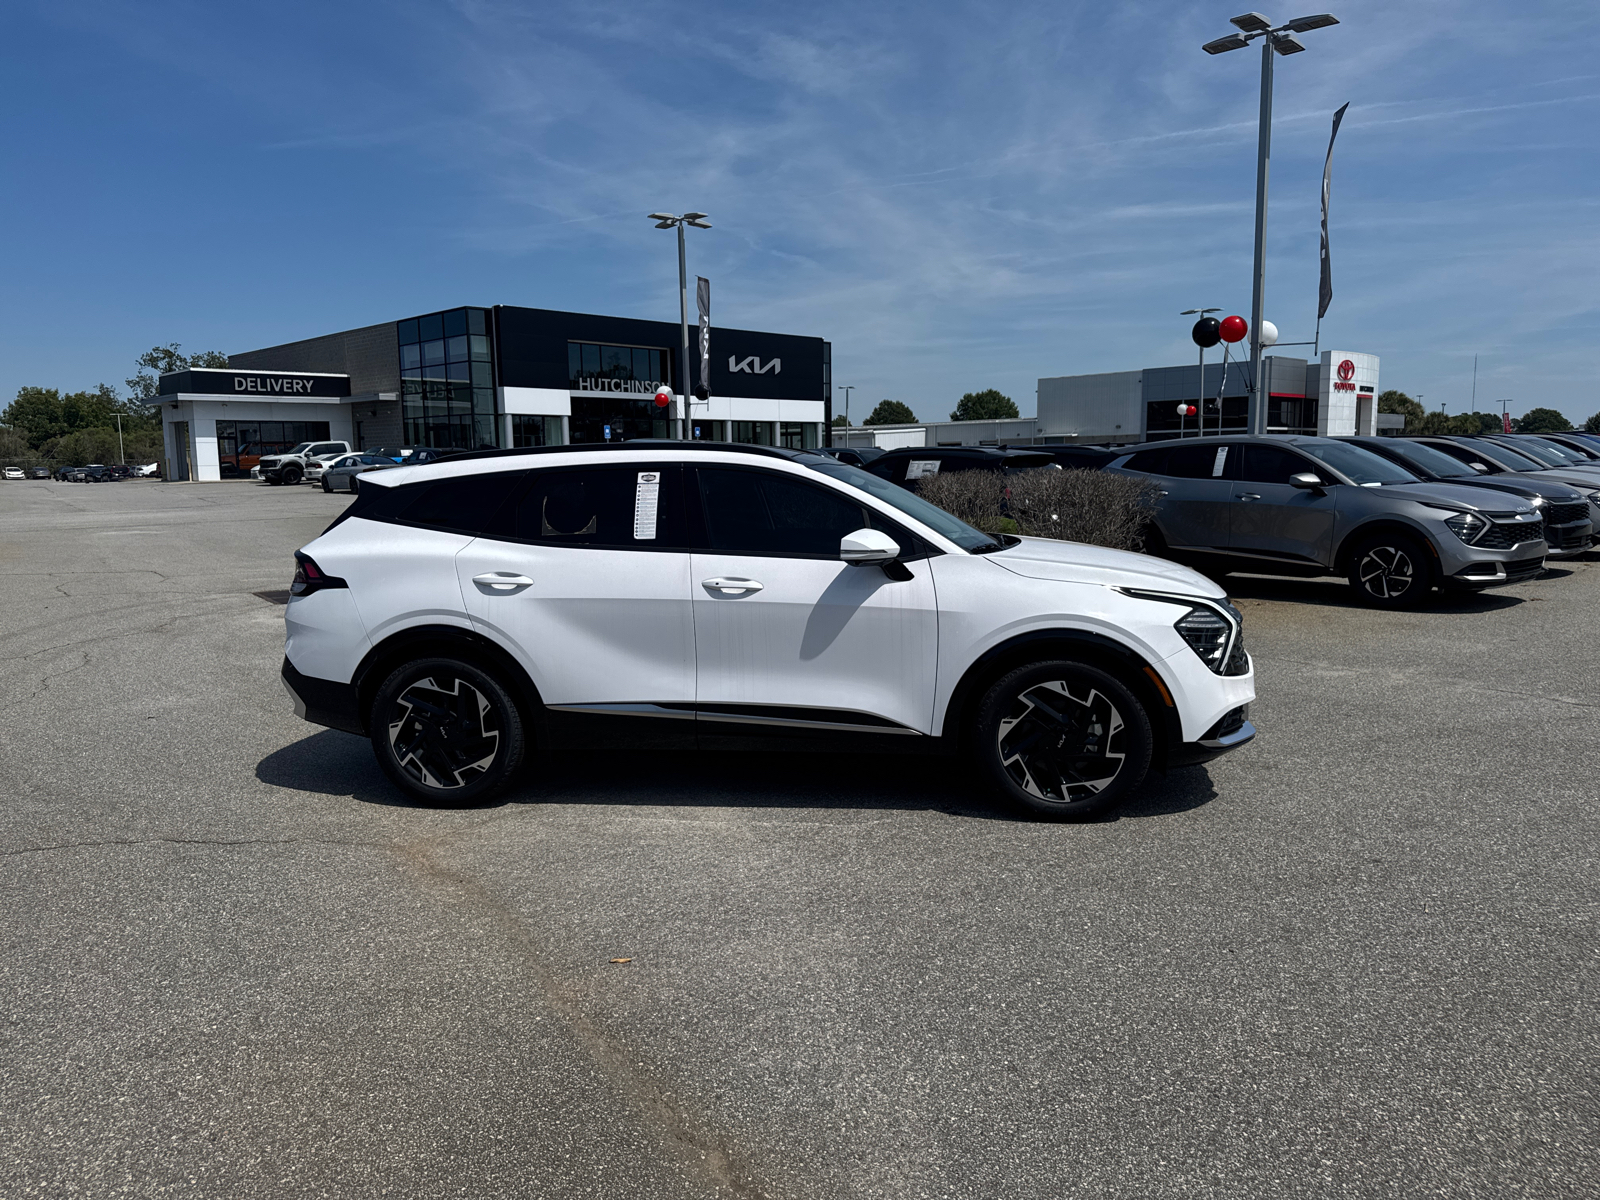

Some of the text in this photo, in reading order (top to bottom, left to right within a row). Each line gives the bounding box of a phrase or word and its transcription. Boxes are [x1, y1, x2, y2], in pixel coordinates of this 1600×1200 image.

[728, 354, 781, 375] KIA
[234, 377, 314, 393] DELIVERY
[1334, 382, 1356, 391] TOYOTA
